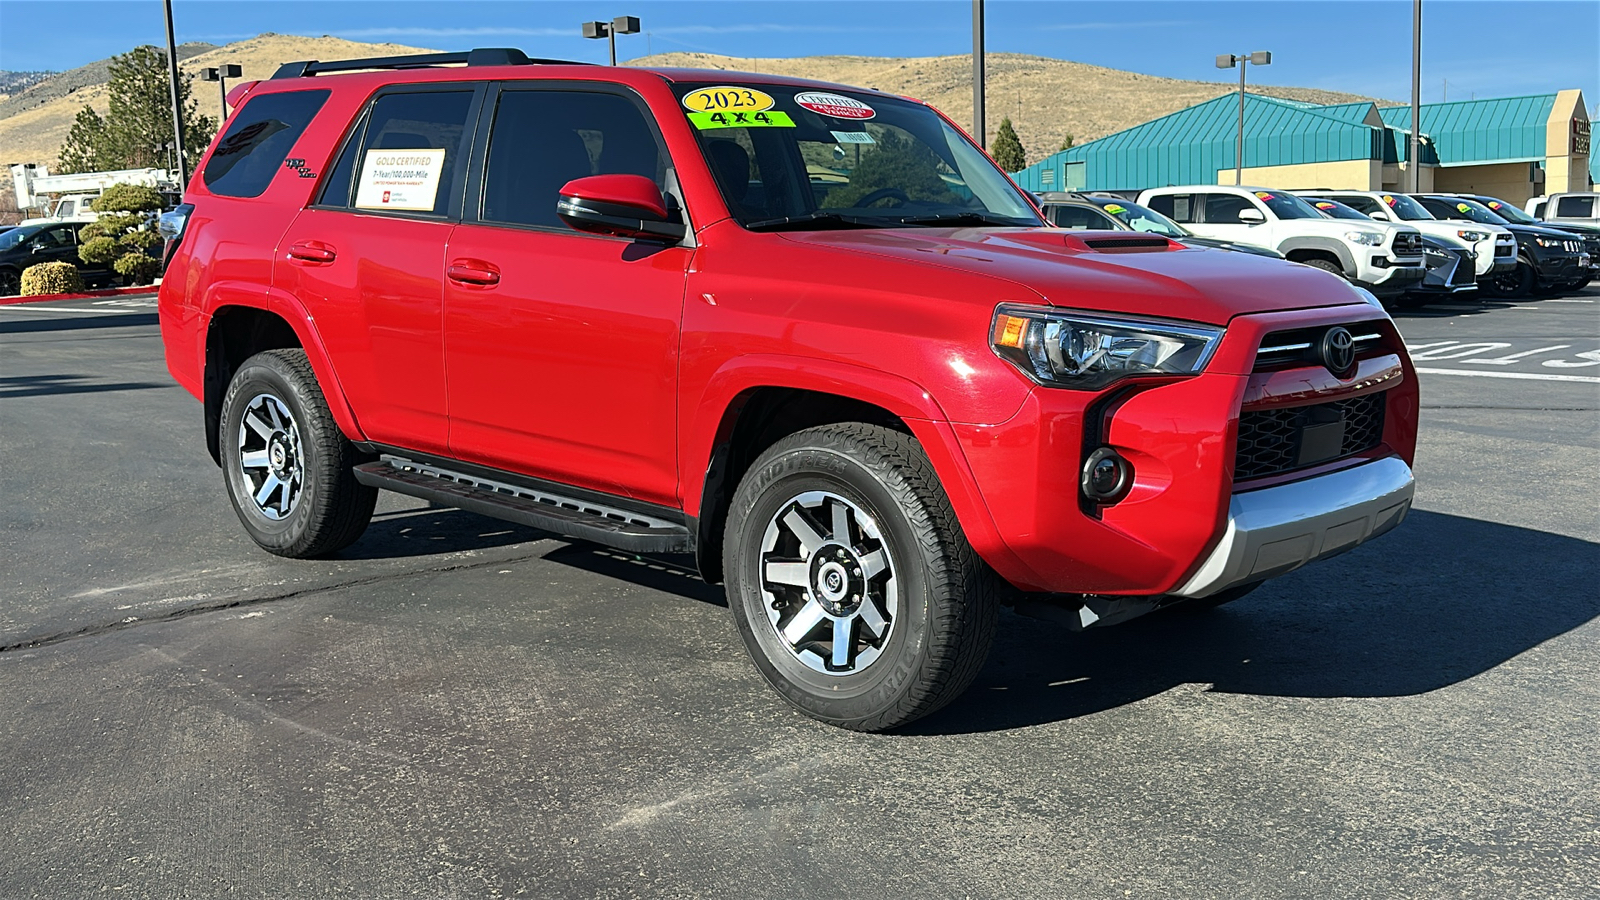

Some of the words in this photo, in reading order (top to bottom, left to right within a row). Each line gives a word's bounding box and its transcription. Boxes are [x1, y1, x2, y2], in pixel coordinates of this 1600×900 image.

[699, 90, 757, 110] 2023
[801, 95, 863, 108] CERTIFIED
[376, 157, 396, 166] GOLD
[396, 157, 431, 166] CERTIFIED
[373, 170, 428, 179] 7-Year/100,000-Mile
